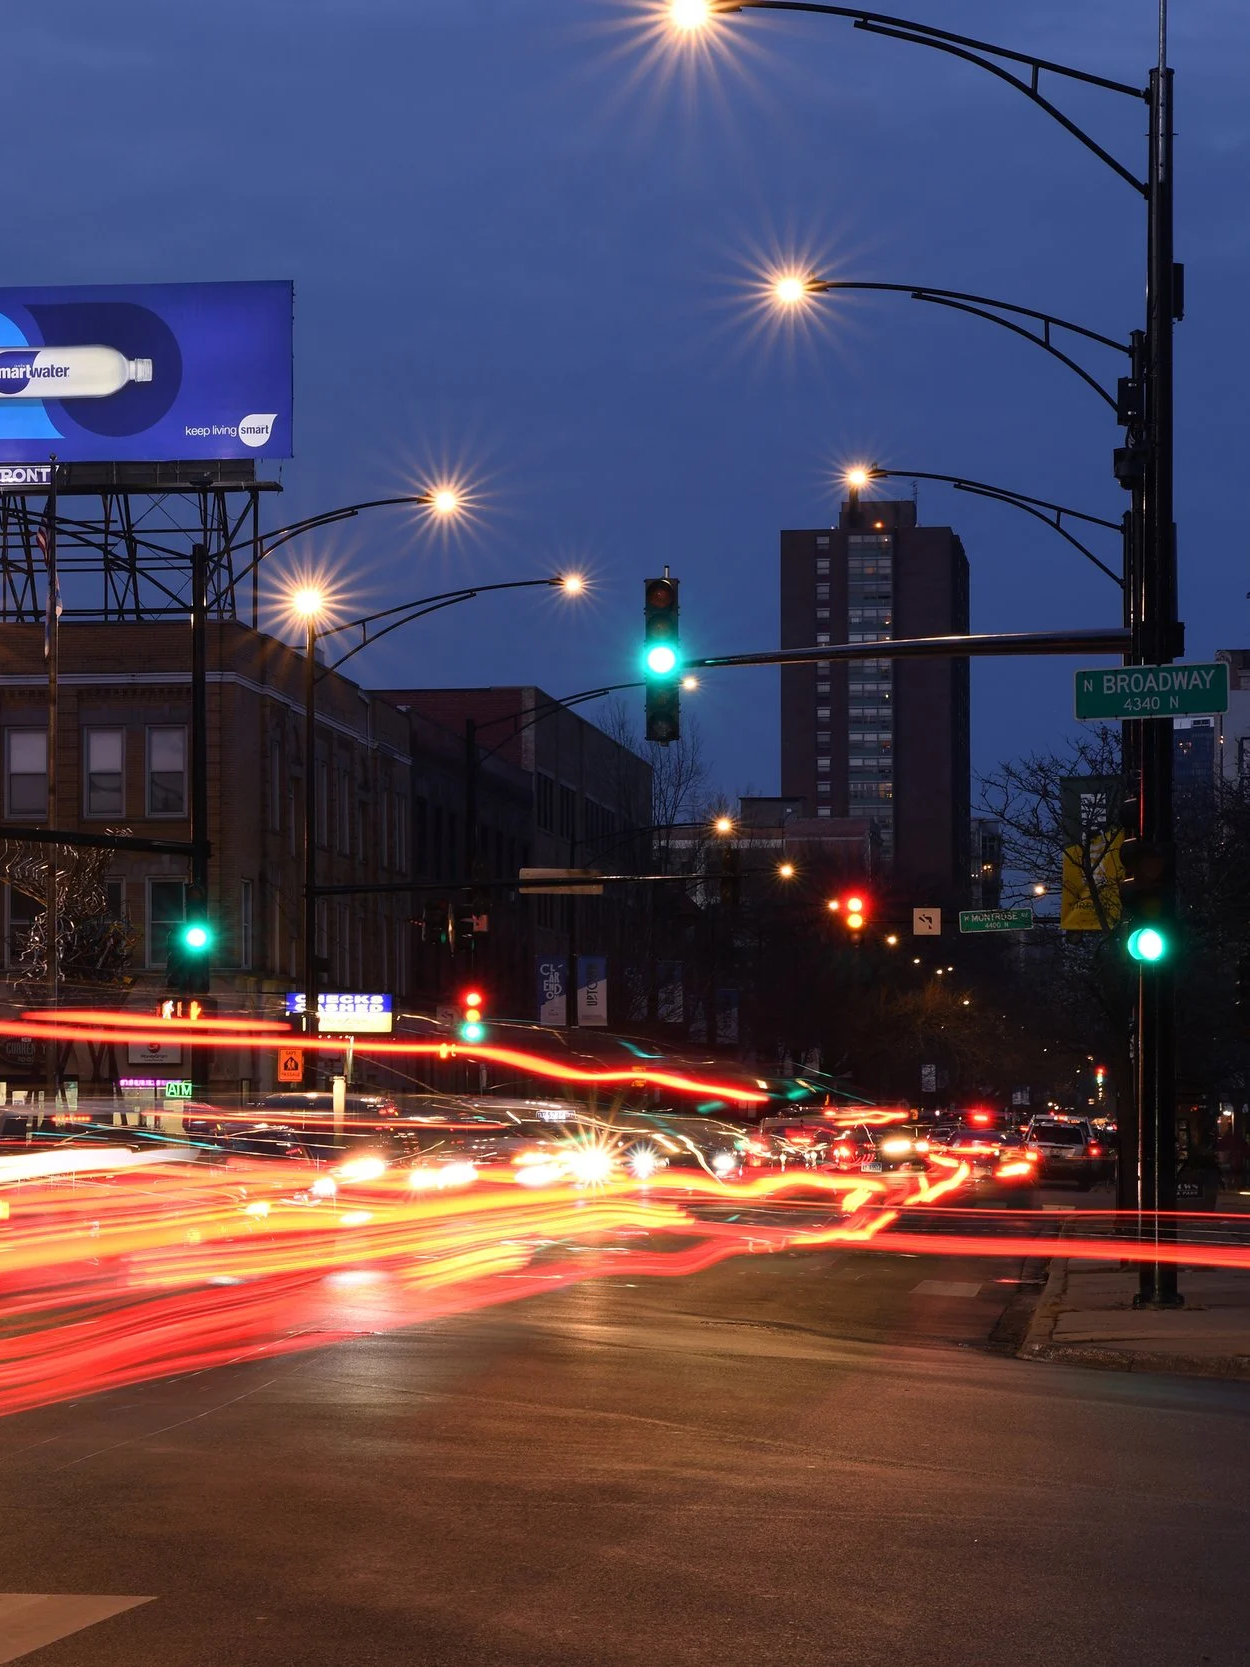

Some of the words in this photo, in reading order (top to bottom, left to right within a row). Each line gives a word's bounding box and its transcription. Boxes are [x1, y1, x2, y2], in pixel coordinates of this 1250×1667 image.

[185, 426, 210, 437] keep
[212, 425, 237, 437] living
[241, 425, 269, 434] smart
[1083, 679, 1093, 692] N
[1103, 669, 1215, 694] BROADWAY
[1123, 696, 1160, 711] 4340
[1169, 696, 1179, 709] N
[971, 911, 1018, 922] MONTROSE
[5, 1042, 47, 1055] CURRENY
[168, 1083, 192, 1096] ATM
